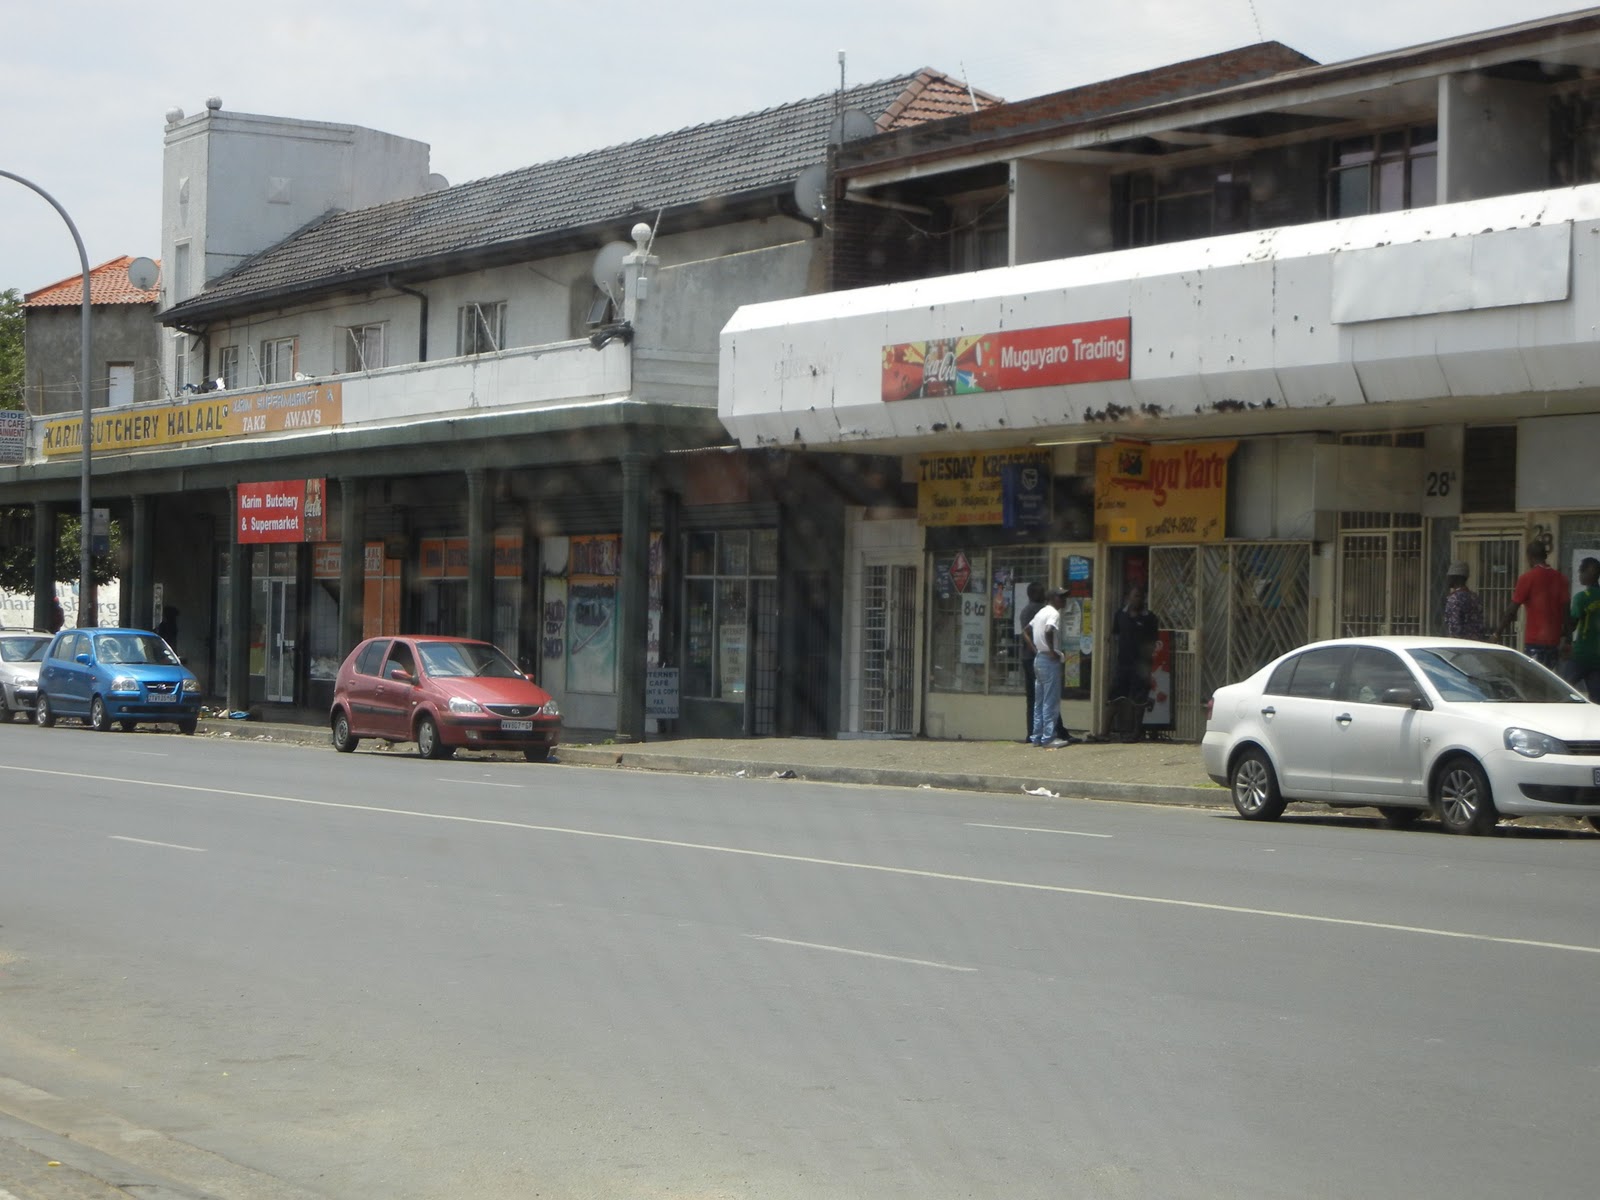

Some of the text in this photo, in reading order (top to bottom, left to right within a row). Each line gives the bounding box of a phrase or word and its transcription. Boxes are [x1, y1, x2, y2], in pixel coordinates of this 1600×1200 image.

[1001, 337, 1126, 372] Muguyaro Trading
[257, 390, 319, 410] SUPERMARKET
[46, 423, 83, 449] KARIM
[167, 406, 223, 436] HALAAL
[243, 409, 321, 432] TAKE AWAYS
[919, 455, 976, 481] TUESDAY
[241, 493, 299, 511] Karim Butchery
[241, 515, 299, 534] & Supermarket
